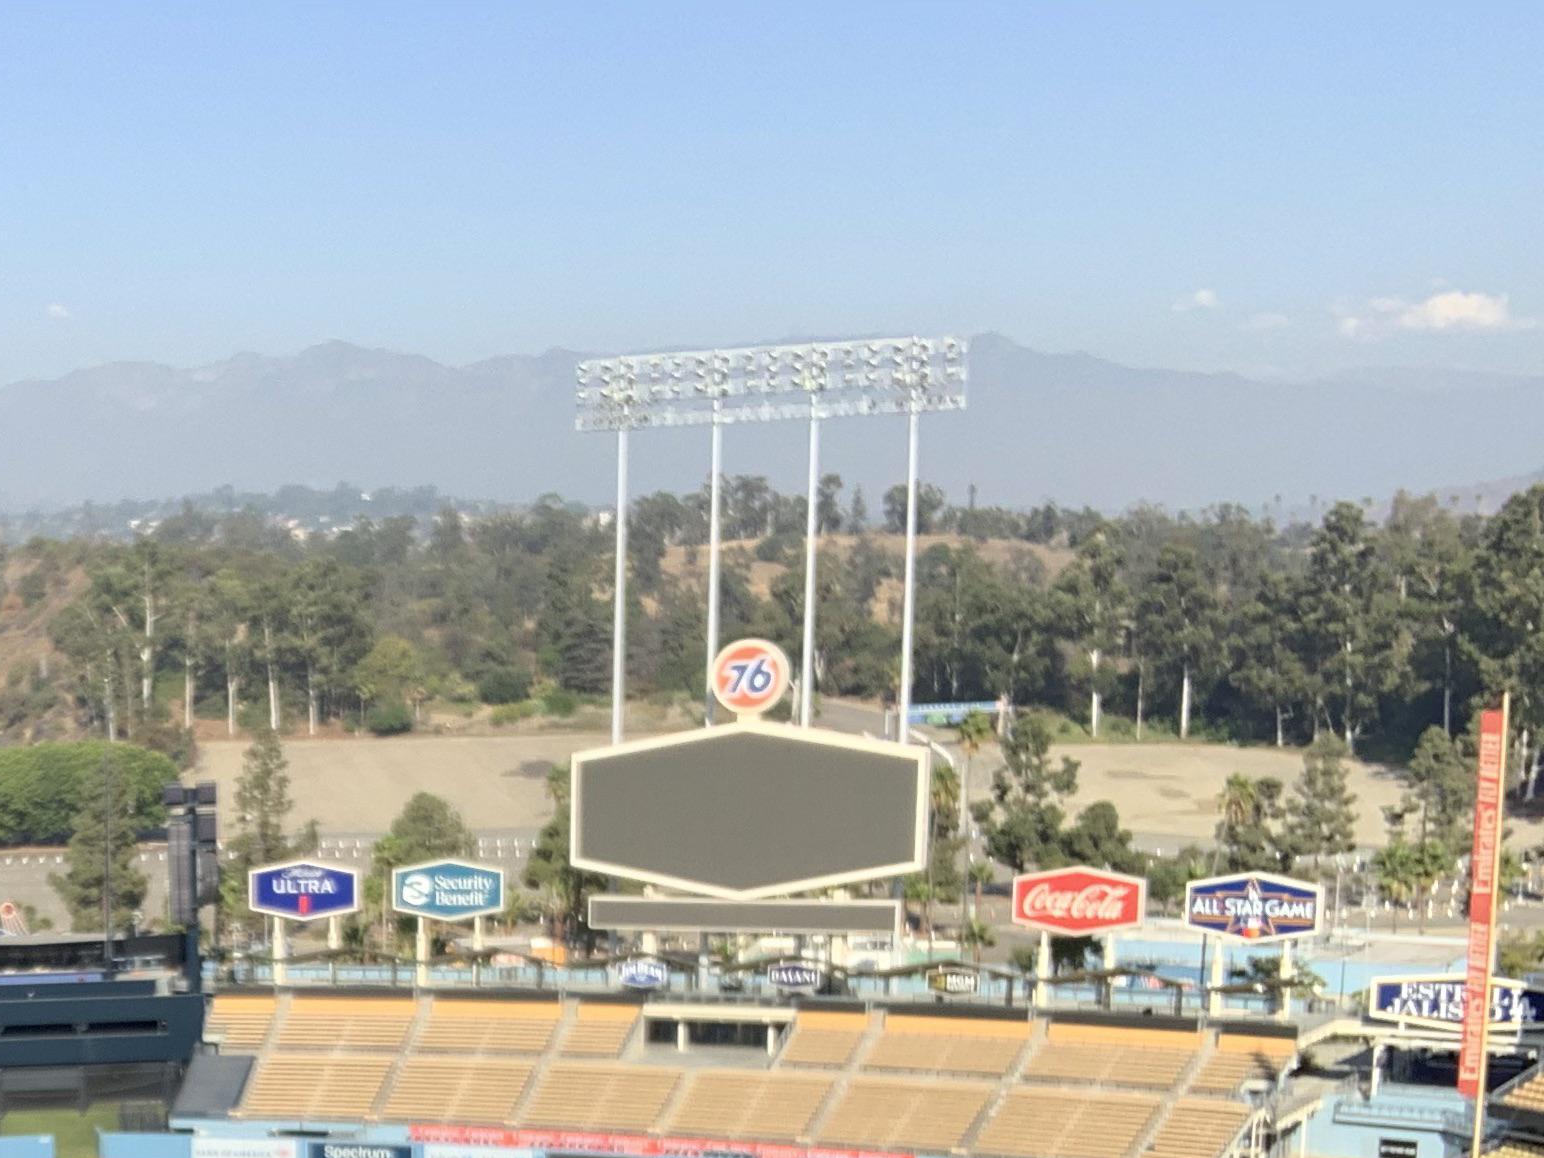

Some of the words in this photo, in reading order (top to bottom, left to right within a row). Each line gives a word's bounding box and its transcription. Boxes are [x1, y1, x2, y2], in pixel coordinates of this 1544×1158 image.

[723, 657, 774, 697] 76
[271, 878, 336, 895] ULTRA
[434, 875, 493, 892] Security
[435, 891, 487, 906] Benefit
[1192, 896, 1219, 915] ALL
[1224, 897, 1263, 917] STAR
[1265, 900, 1314, 919] GAME
